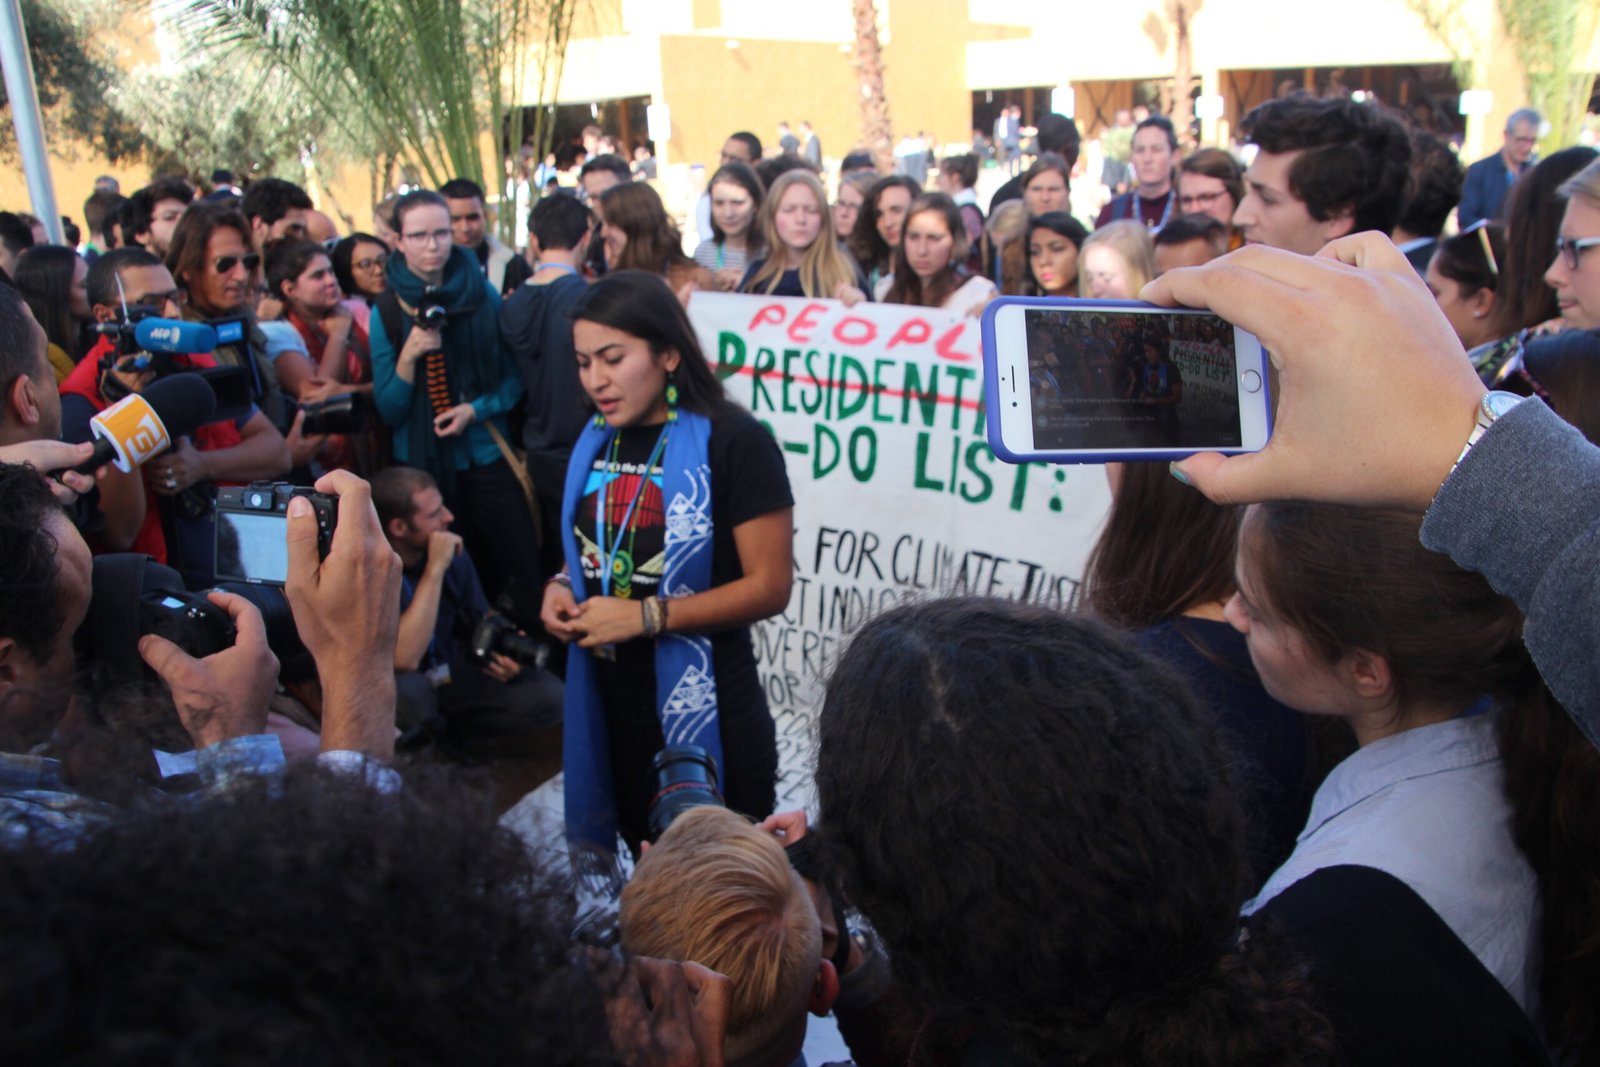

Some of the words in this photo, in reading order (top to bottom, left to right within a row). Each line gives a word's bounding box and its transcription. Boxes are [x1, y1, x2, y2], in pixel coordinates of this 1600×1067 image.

[748, 303, 983, 362] PEOPL
[759, 419, 878, 484] -DO
[813, 526, 883, 581] FOR
